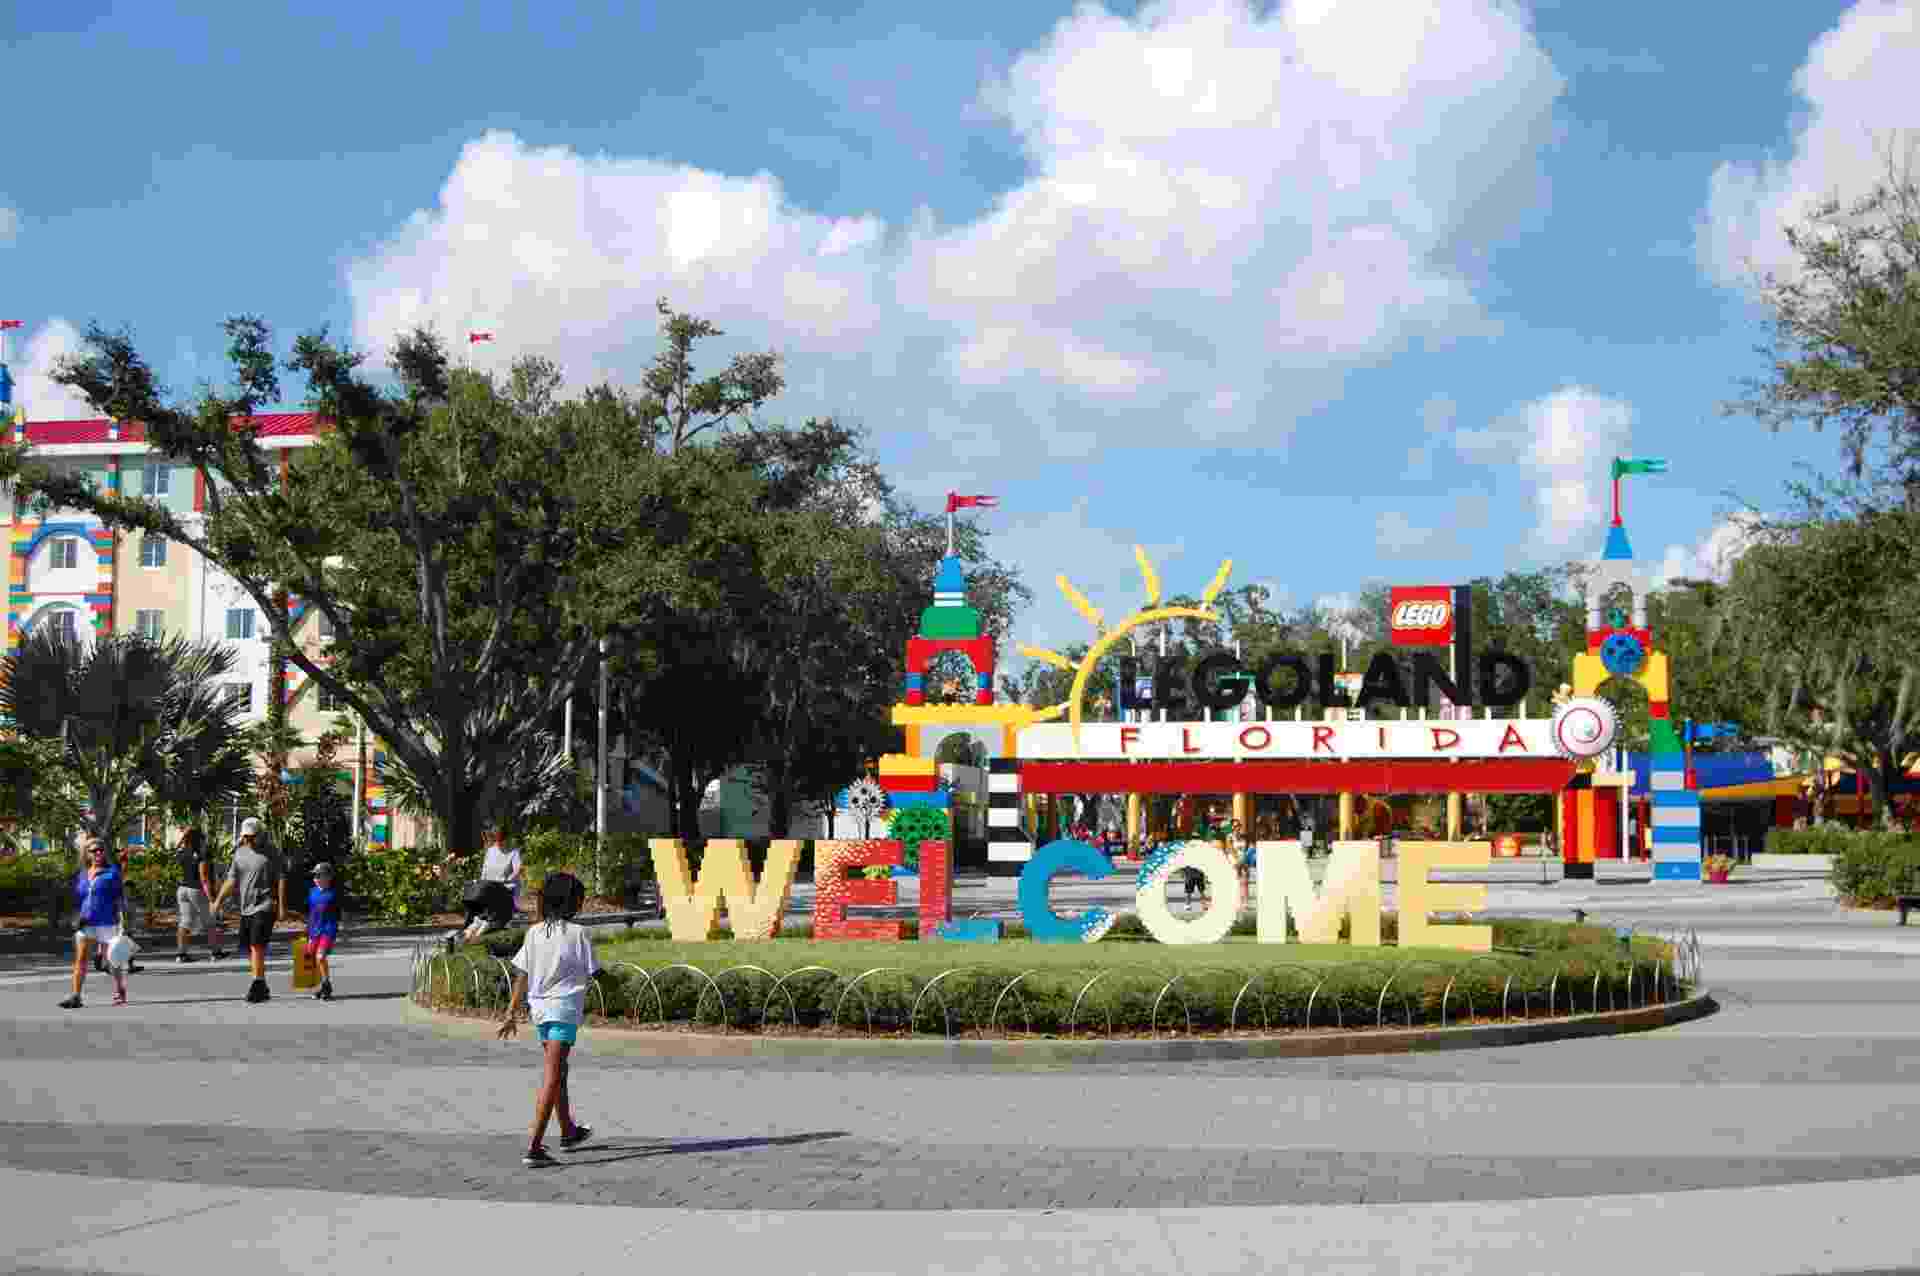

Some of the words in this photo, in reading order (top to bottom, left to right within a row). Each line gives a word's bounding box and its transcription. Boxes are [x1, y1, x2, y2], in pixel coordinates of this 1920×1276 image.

[1396, 603, 1447, 627] LEGO
[1119, 651, 1530, 707] LEGOLAND
[1120, 724, 1527, 753] FLORIDA
[648, 839, 1493, 950] WELCOME
